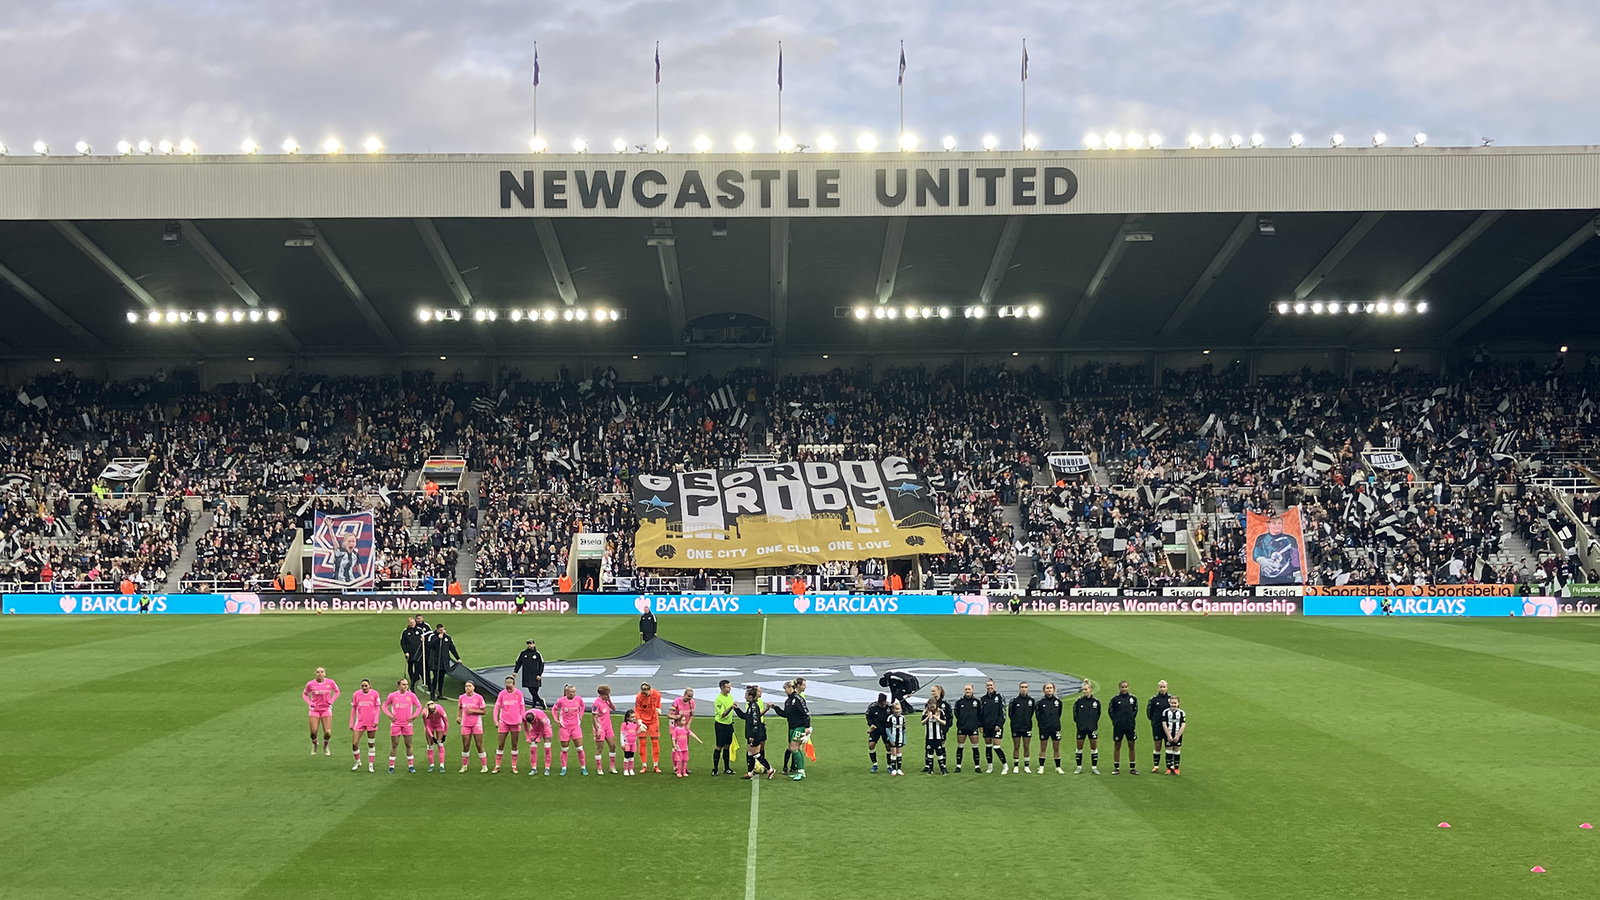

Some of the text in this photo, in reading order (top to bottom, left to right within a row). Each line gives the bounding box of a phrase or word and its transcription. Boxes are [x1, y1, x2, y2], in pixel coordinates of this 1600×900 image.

[500, 167, 1078, 210] NEWCASTLE UNITED
[638, 457, 917, 490] GEORDIE
[687, 484, 886, 517] PRIDE
[687, 539, 891, 560] ONE CITY ONE CLUB ONE LOVE
[279, 598, 301, 611] for
[304, 598, 329, 611] the
[332, 598, 393, 614] Barclays
[397, 598, 462, 611] Women's
[466, 598, 570, 614] Champonship
[656, 597, 740, 612] BARCLAYS
[815, 596, 899, 612] BARCLAYS
[1032, 598, 1056, 612] the
[1059, 598, 1120, 615] Barclays
[1123, 598, 1188, 613] Women's
[1191, 598, 1296, 615] Championship
[1386, 598, 1466, 614] ARCLAYS
[1576, 600, 1597, 613] for
